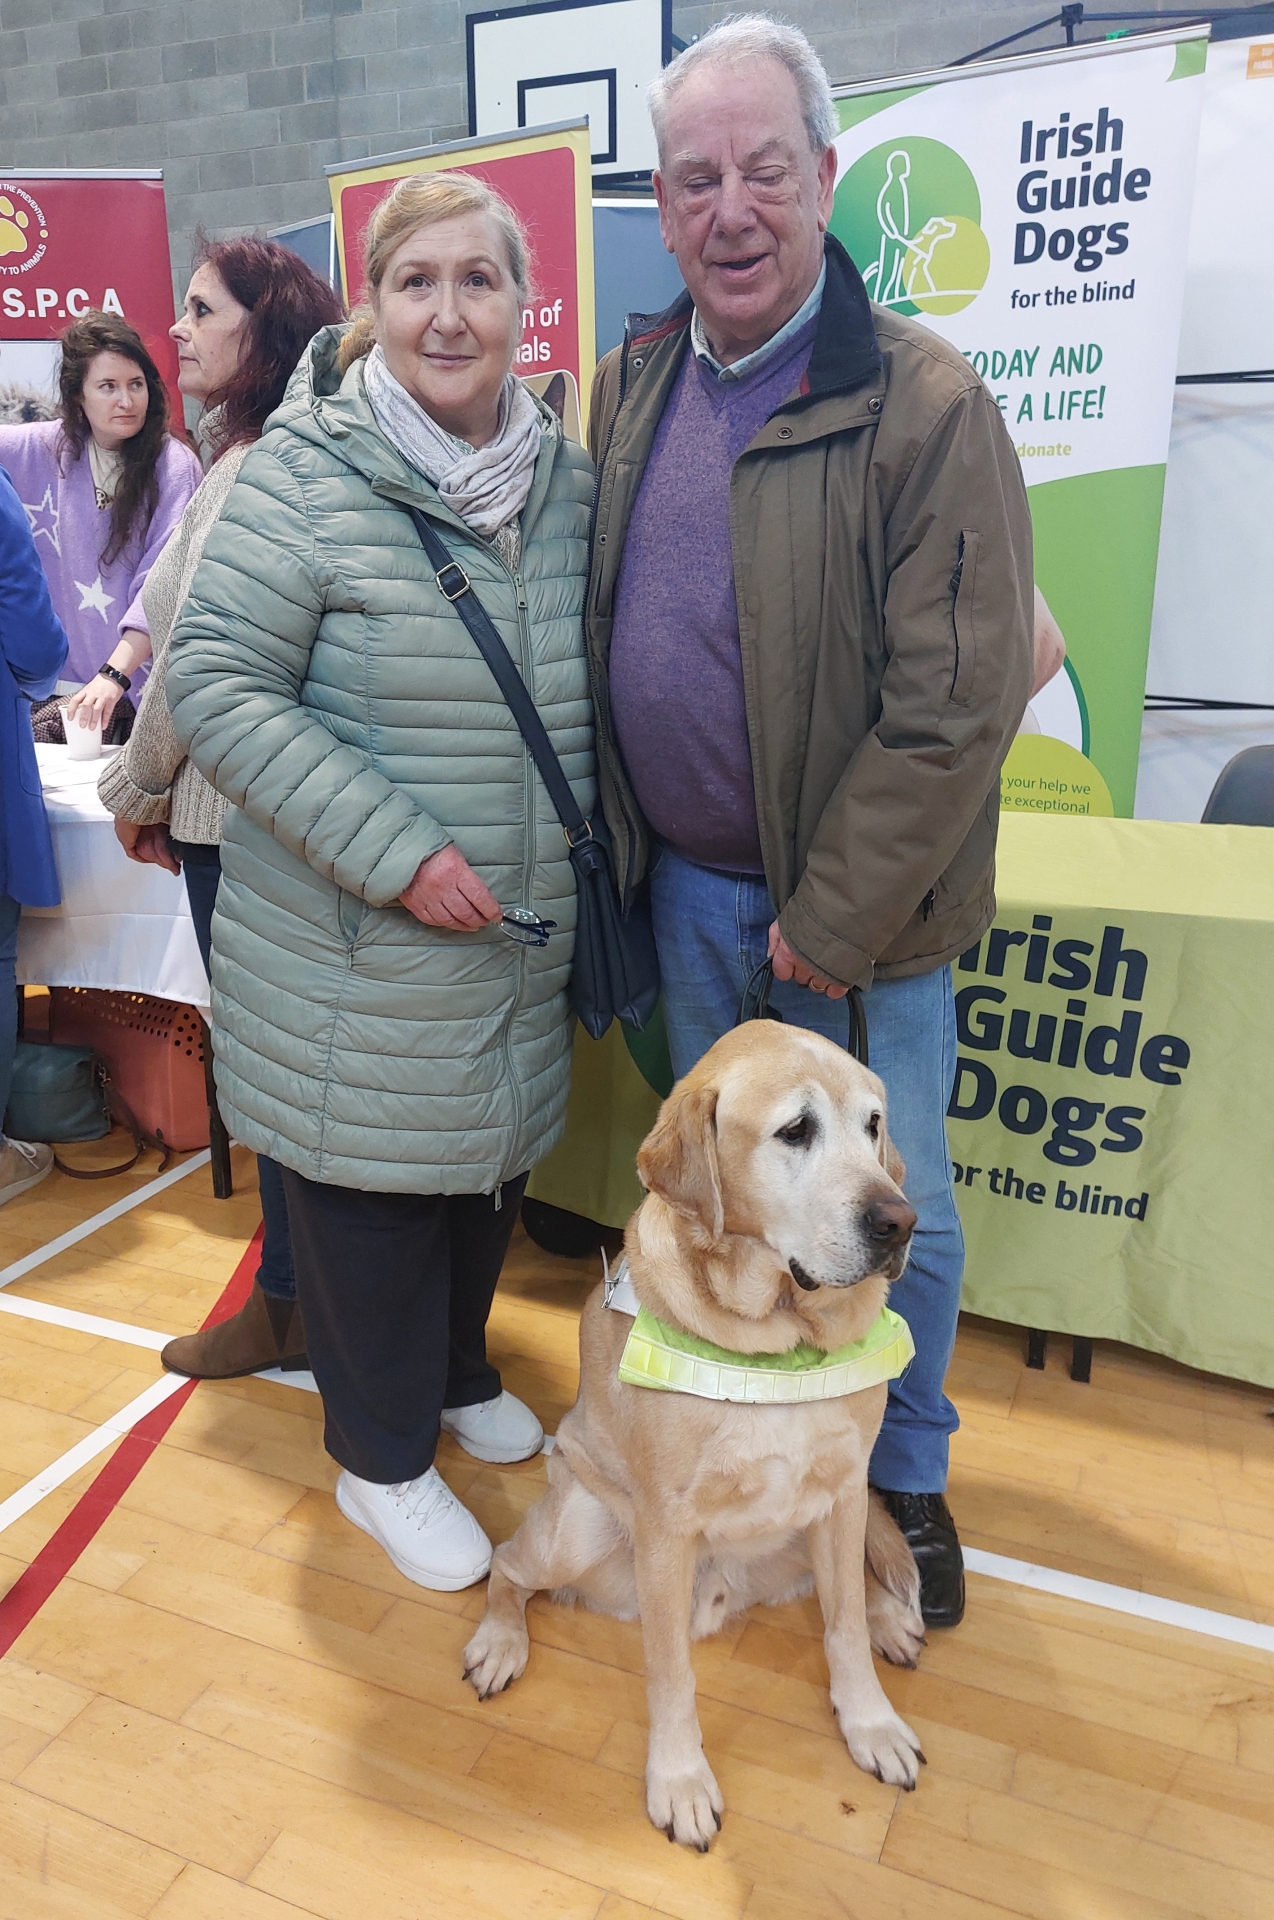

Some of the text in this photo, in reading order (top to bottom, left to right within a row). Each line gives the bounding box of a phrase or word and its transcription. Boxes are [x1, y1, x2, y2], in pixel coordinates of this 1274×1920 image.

[1020, 107, 1124, 164] Irish
[1016, 158, 1151, 214] Guide
[3, 183, 47, 227] THE PREVENTION
[8, 266, 19, 275] TO
[20, 243, 47, 273] ANIMALS
[1013, 221, 1130, 272] Dogs
[2, 288, 125, 318] S.P.CA
[1010, 279, 1135, 309] for the blind
[540, 298, 562, 327] of
[1049, 343, 1103, 377] AND
[1016, 393, 1033, 424] A
[1043, 385, 1106, 421] LIFE!
[1016, 442, 1072, 458] donate
[1007, 777, 1036, 789] your
[1039, 778, 1068, 795] help
[1071, 784, 1091, 795] we
[1014, 796, 1090, 814] exceptional
[954, 985, 1190, 1085] Guide
[946, 1056, 1147, 1167] Dogs
[951, 1161, 1149, 1221] or the blind
